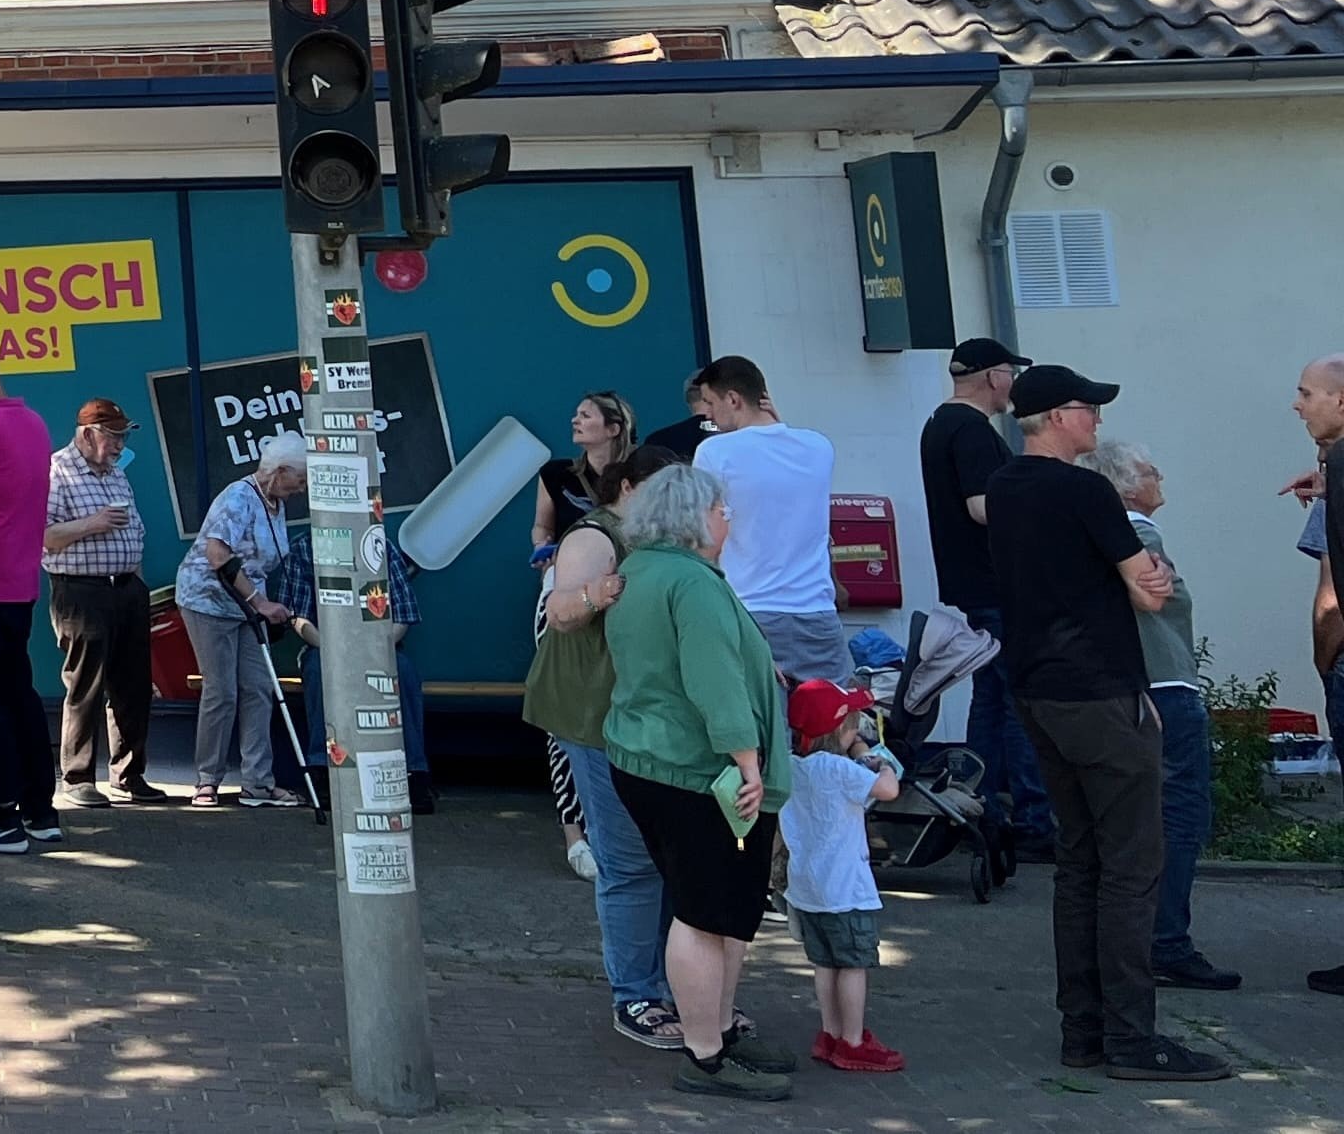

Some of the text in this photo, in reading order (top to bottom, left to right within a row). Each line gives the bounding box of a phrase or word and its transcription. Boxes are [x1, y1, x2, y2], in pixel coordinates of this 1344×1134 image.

[324, 413, 355, 429] ULTRA
[328, 436, 357, 452] TEAM
[358, 711, 389, 728] ULTRA
[357, 814, 390, 831] ULTRA
